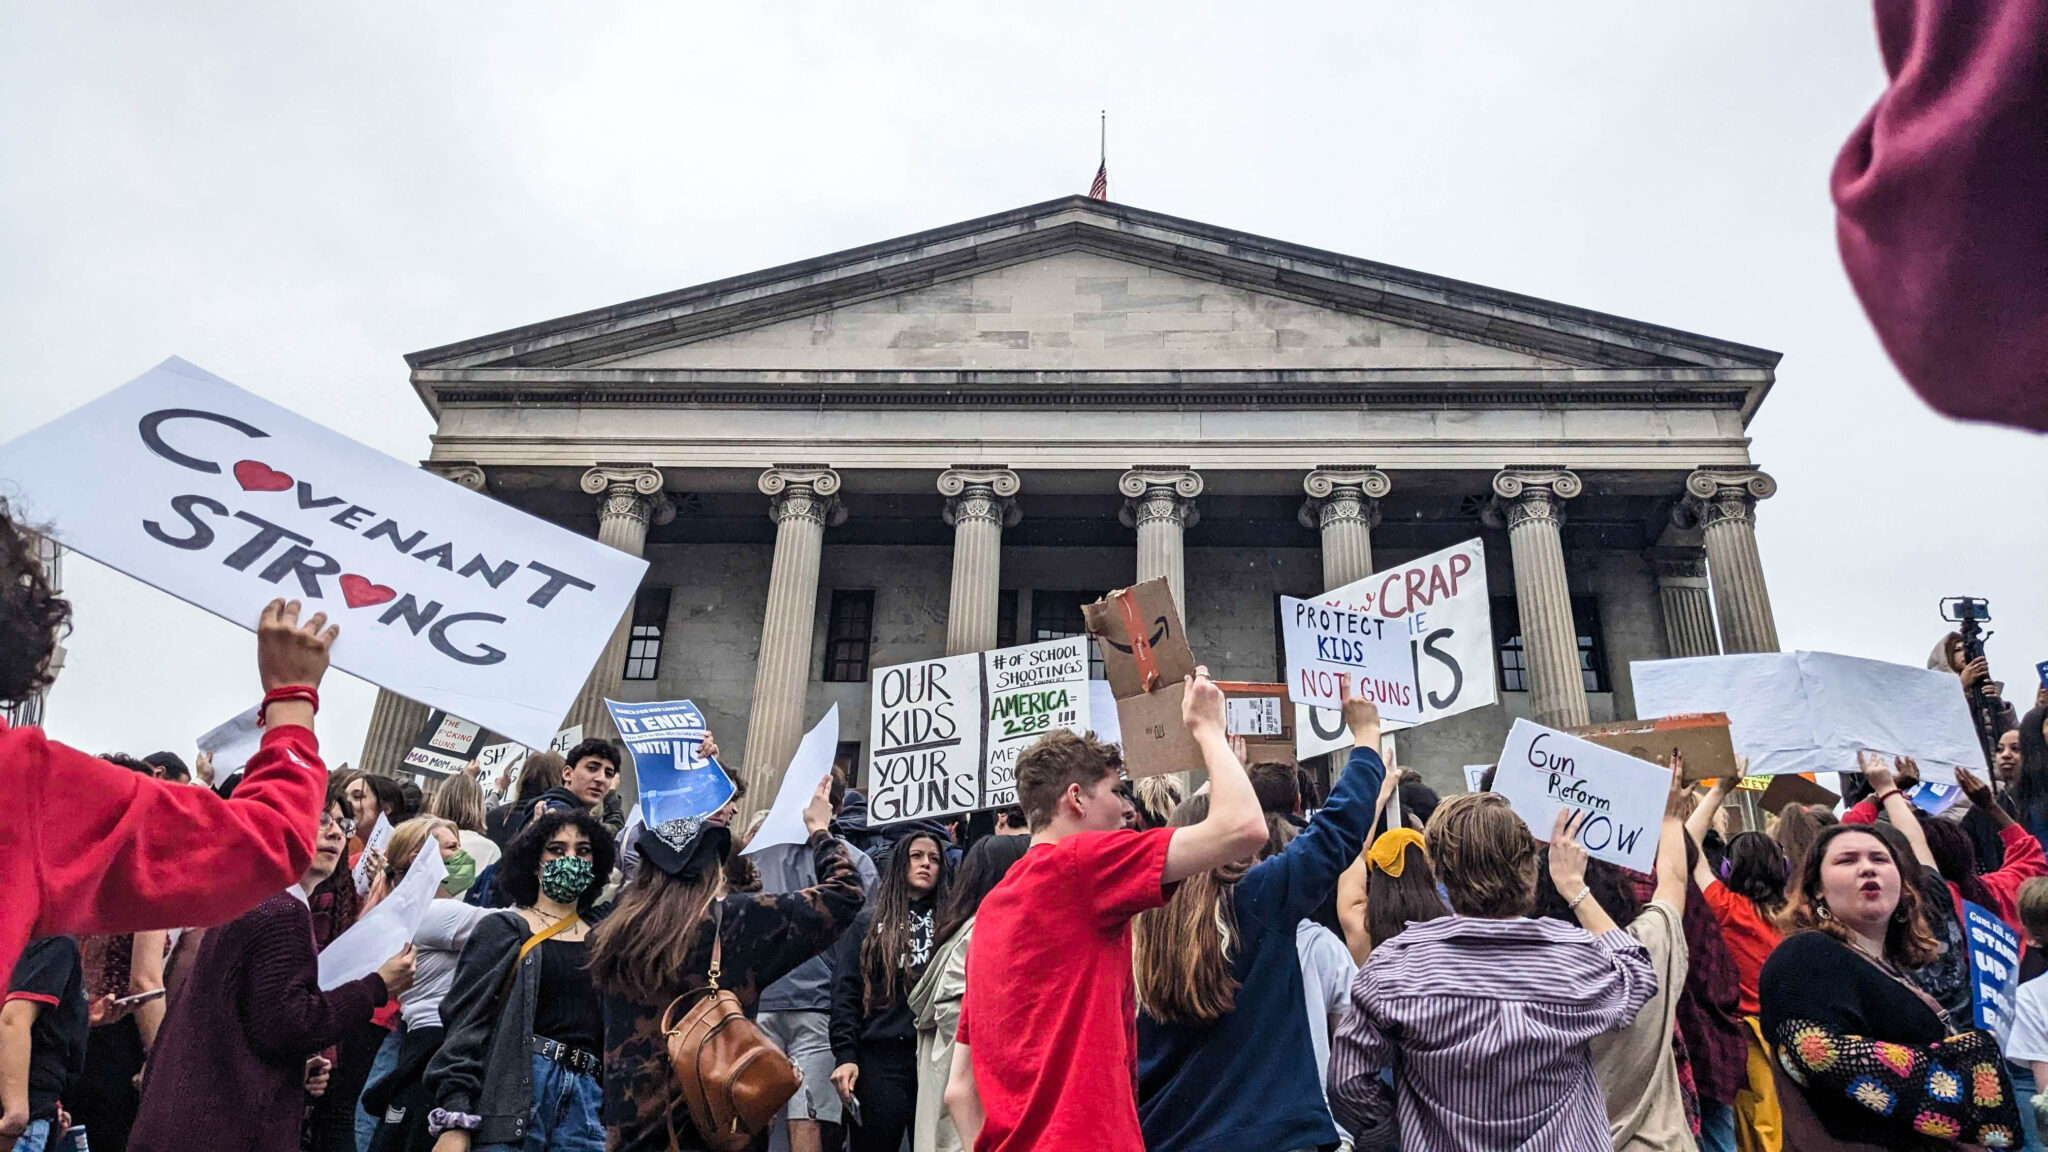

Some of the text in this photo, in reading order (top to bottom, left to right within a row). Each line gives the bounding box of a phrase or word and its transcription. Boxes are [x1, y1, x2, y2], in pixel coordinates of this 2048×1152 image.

[1379, 554, 1471, 618] CRAP
[1296, 603, 1385, 640] PROTECT
[1029, 645, 1080, 666] SCHOOL
[1318, 635, 1363, 662] KIDS
[881, 663, 951, 709] OUR
[996, 660, 1083, 688] SHOOTINGS
[1301, 668, 1410, 706] NOT GUNS
[444, 718, 461, 729] THE
[617, 712, 702, 732] IT ENDS
[881, 702, 956, 747] KIDS
[1003, 713, 1050, 735] 288
[406, 751, 428, 763] MAD
[429, 757, 451, 769] MOM
[632, 741, 710, 769] WITH US
[873, 750, 949, 787] YOUR
[1528, 733, 1575, 776] Gun
[871, 774, 975, 821] GUNS
[1548, 773, 1610, 811] Reform
[1971, 927, 2018, 967] STAND
[1975, 950, 2007, 982] UP
